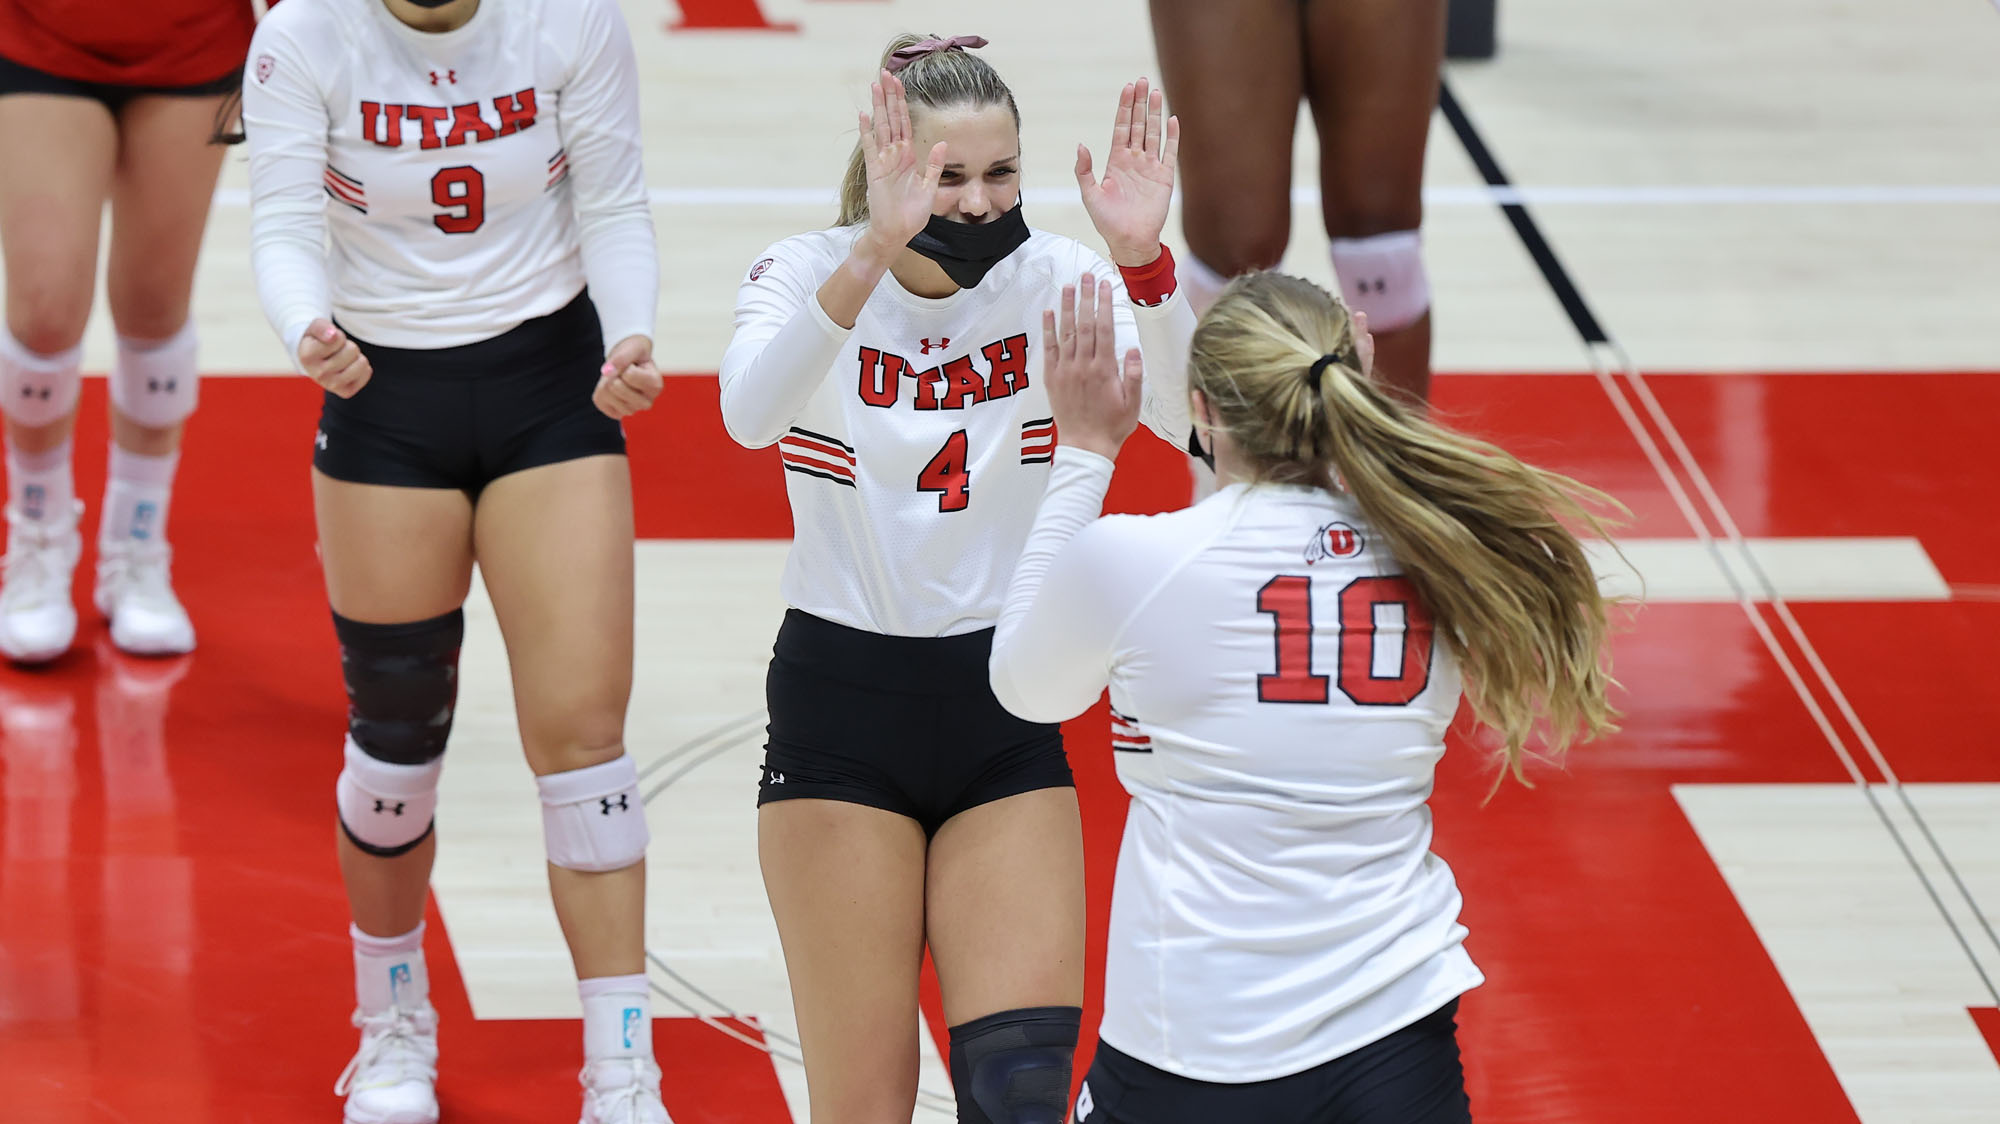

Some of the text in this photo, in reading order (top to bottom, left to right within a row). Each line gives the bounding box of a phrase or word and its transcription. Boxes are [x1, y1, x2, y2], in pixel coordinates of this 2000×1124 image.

[361, 87, 538, 150] UTAH
[431, 165, 485, 234] 9
[858, 333, 1030, 411] UTAH
[917, 428, 971, 513] 4
[1329, 530, 1355, 555] U
[1256, 574, 1436, 706] 10
